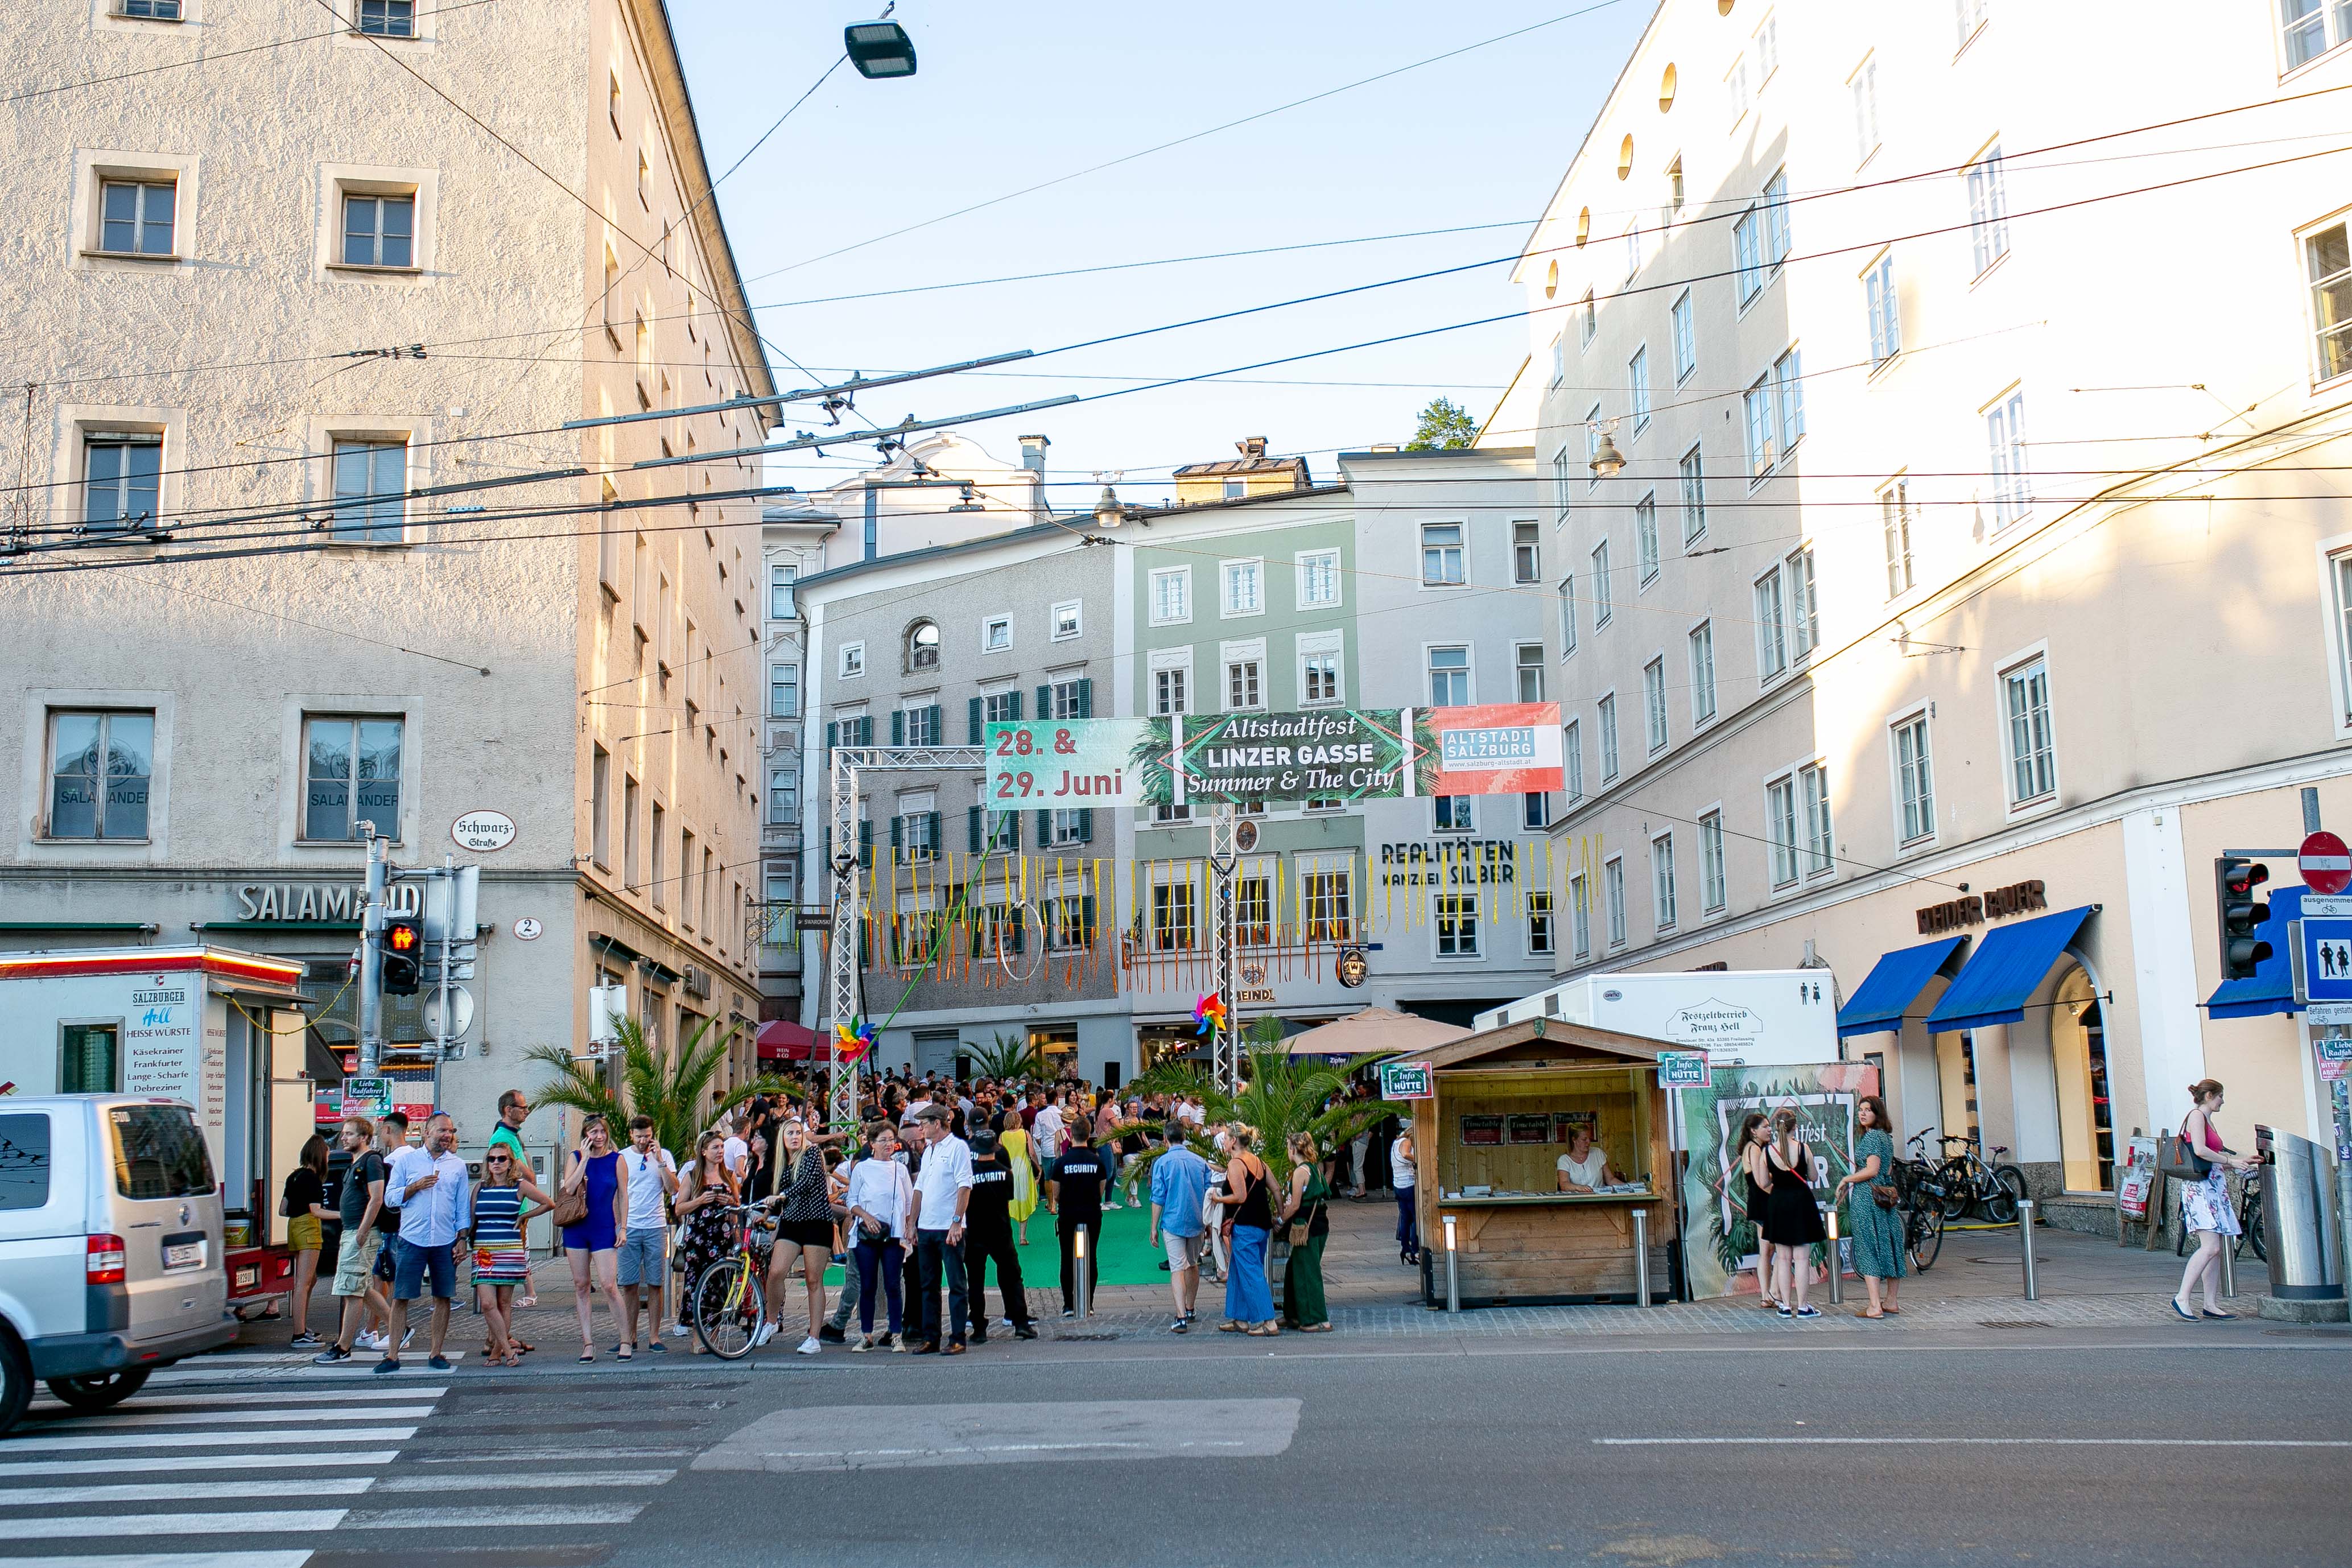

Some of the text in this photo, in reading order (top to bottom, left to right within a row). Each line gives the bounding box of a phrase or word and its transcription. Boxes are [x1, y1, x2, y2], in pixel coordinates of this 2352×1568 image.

[1222, 715, 1358, 741] Altstadtfest
[996, 728, 1078, 756] 28. &
[1447, 730, 1530, 745] ALTSTADT
[1207, 744, 1374, 768] LINZER GASSE
[1447, 743, 1531, 758] SALZBURG
[1448, 758, 1531, 768] www.salzburg-altstadt.at
[997, 768, 1122, 798] 29. Juni
[1187, 768, 1396, 793] Summer & The City
[469, 838, 497, 848] Straße
[1381, 837, 1513, 864] REALITÄTEN
[1450, 864, 1514, 884] SILBER
[523, 919, 532, 932] 2
[133, 992, 185, 1003] SALZBURGER
[1681, 1010, 1747, 1022] Festzeltbetrieb
[2309, 1006, 2332, 1015] Befahren
[142, 1006, 174, 1027] Hell
[126, 1027, 191, 1038] HEISSE WÜRSTE
[1690, 1023, 1718, 1033] Franz
[133, 1047, 184, 1056] Käsekrainer
[134, 1059, 183, 1068] Frankfurter
[1676, 1060, 1693, 1070] Info
[1399, 1071, 1416, 1081] Info
[1670, 1070, 1699, 1079] HÜTTE
[134, 1084, 182, 1092] Debreziner
[352, 1087, 383, 1095] Radfahrer
[1394, 1080, 1421, 1091] HÜTTE
[1064, 1163, 1097, 1174] SECURITY
[972, 1171, 1006, 1185] SECURITY
